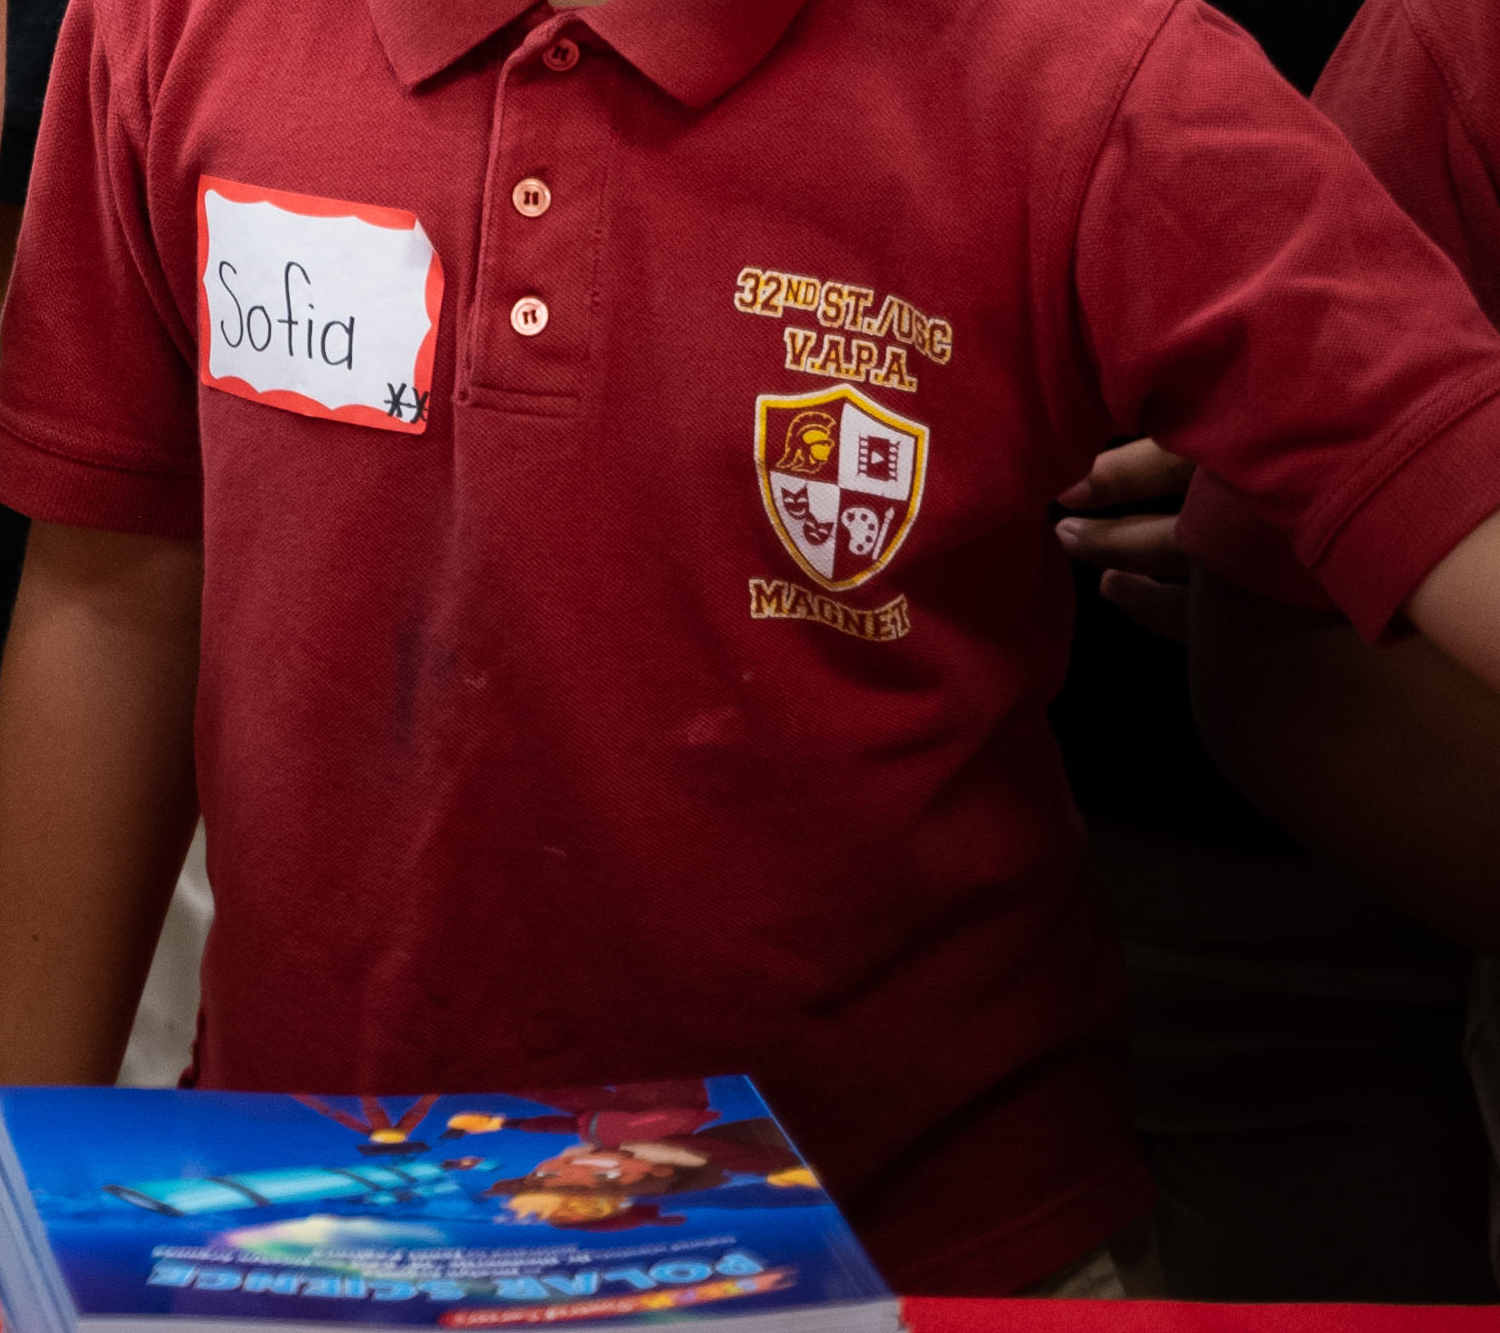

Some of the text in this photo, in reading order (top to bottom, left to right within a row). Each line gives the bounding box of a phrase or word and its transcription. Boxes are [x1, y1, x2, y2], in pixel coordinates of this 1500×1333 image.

[219, 260, 355, 371] Sofia
[783, 326, 918, 394] V.A.P.A.
[749, 577, 911, 642] MAGNET
[146, 1259, 468, 1303] SCIENCE
